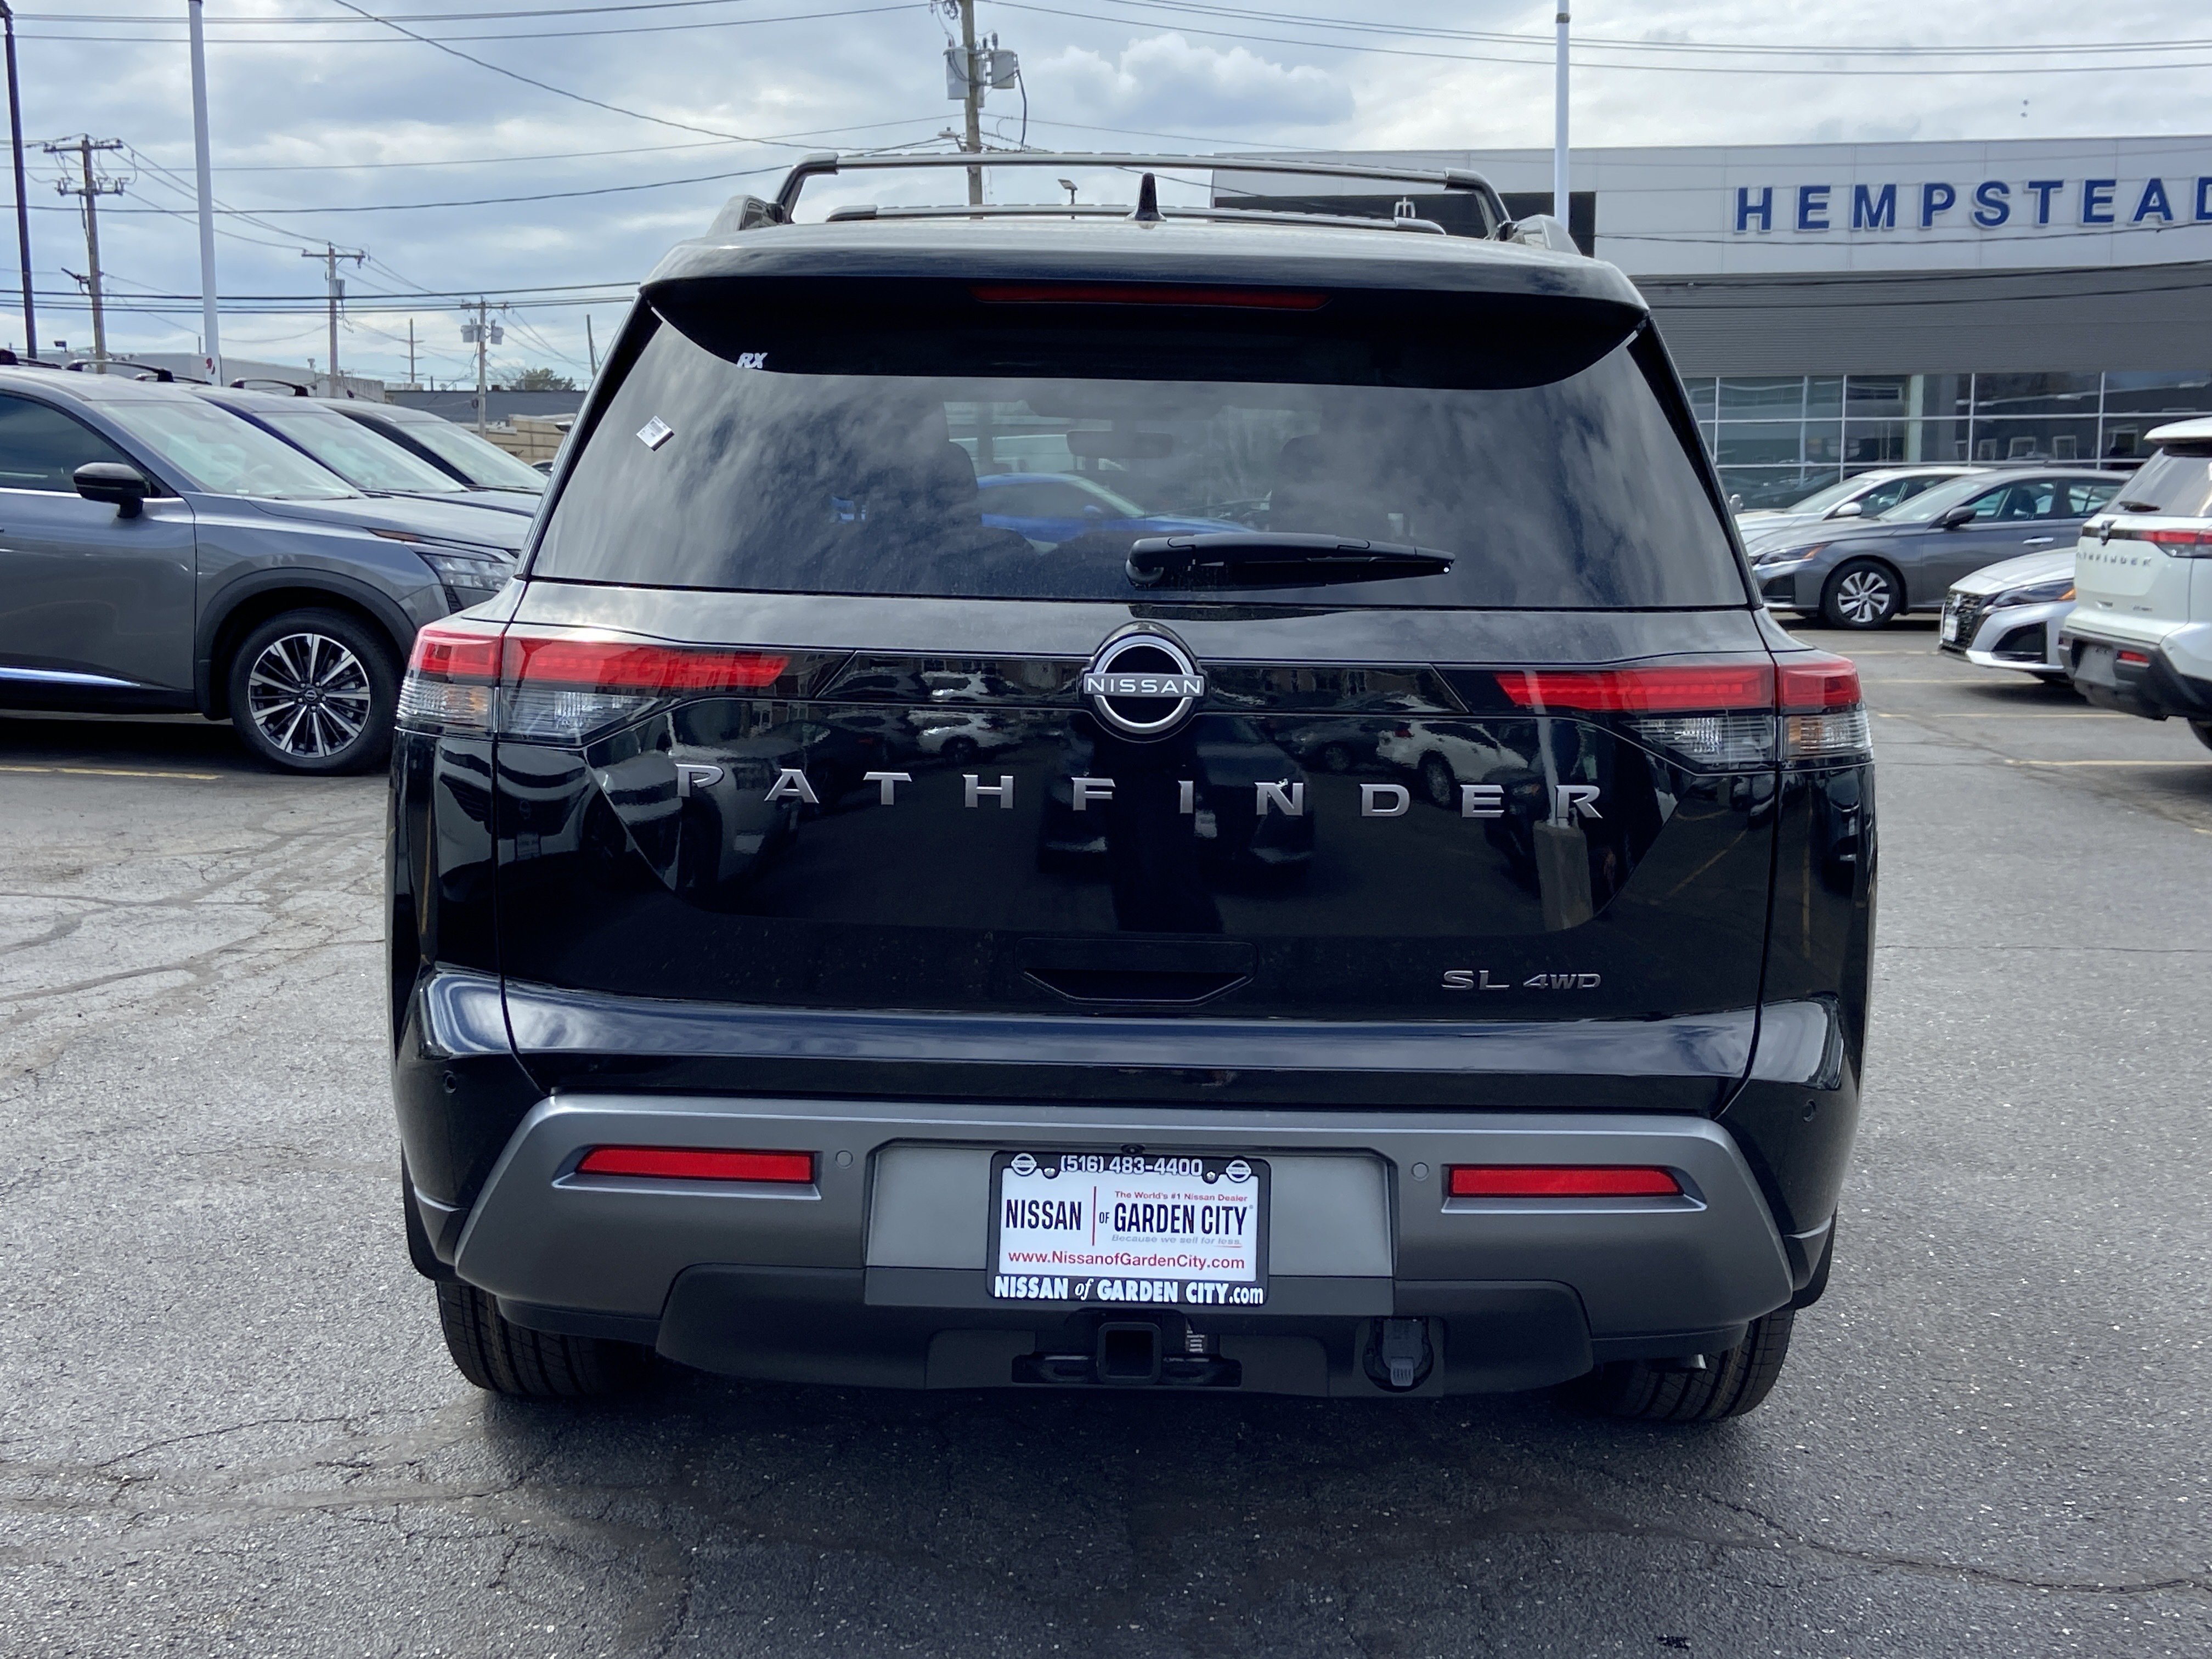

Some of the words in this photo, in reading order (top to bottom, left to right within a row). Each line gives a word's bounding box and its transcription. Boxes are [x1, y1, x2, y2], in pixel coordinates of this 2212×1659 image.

[737, 352, 768, 369] RX
[1087, 678, 1200, 694] NISSAN
[675, 763, 1603, 819] PATHFINDER
[1441, 969, 1510, 990] SL
[1523, 973, 1601, 990] 4WD
[1060, 1155, 1104, 1173] (516)
[1109, 1155, 1203, 1177] 483-4400
[1115, 1190, 1131, 1199] The
[1134, 1191, 1169, 1199] World's
[1184, 1193, 1215, 1201] Nissan
[1217, 1194, 1248, 1202] Dealer
[1006, 1199, 1082, 1231] NISSAN
[1099, 1211, 1110, 1224] OF
[1114, 1203, 1195, 1234] GARDEN
[1201, 1205, 1248, 1235] CITY
[1111, 1234, 1158, 1243] Because
[1180, 1236, 1198, 1244] sell
[1008, 1250, 1245, 1271] www.NissanofGardenCity.com
[994, 1276, 1069, 1300] NISSAN
[1074, 1278, 1094, 1301] of
[1097, 1279, 1179, 1303] GARDEN
[1186, 1281, 1264, 1305] CITY.com
